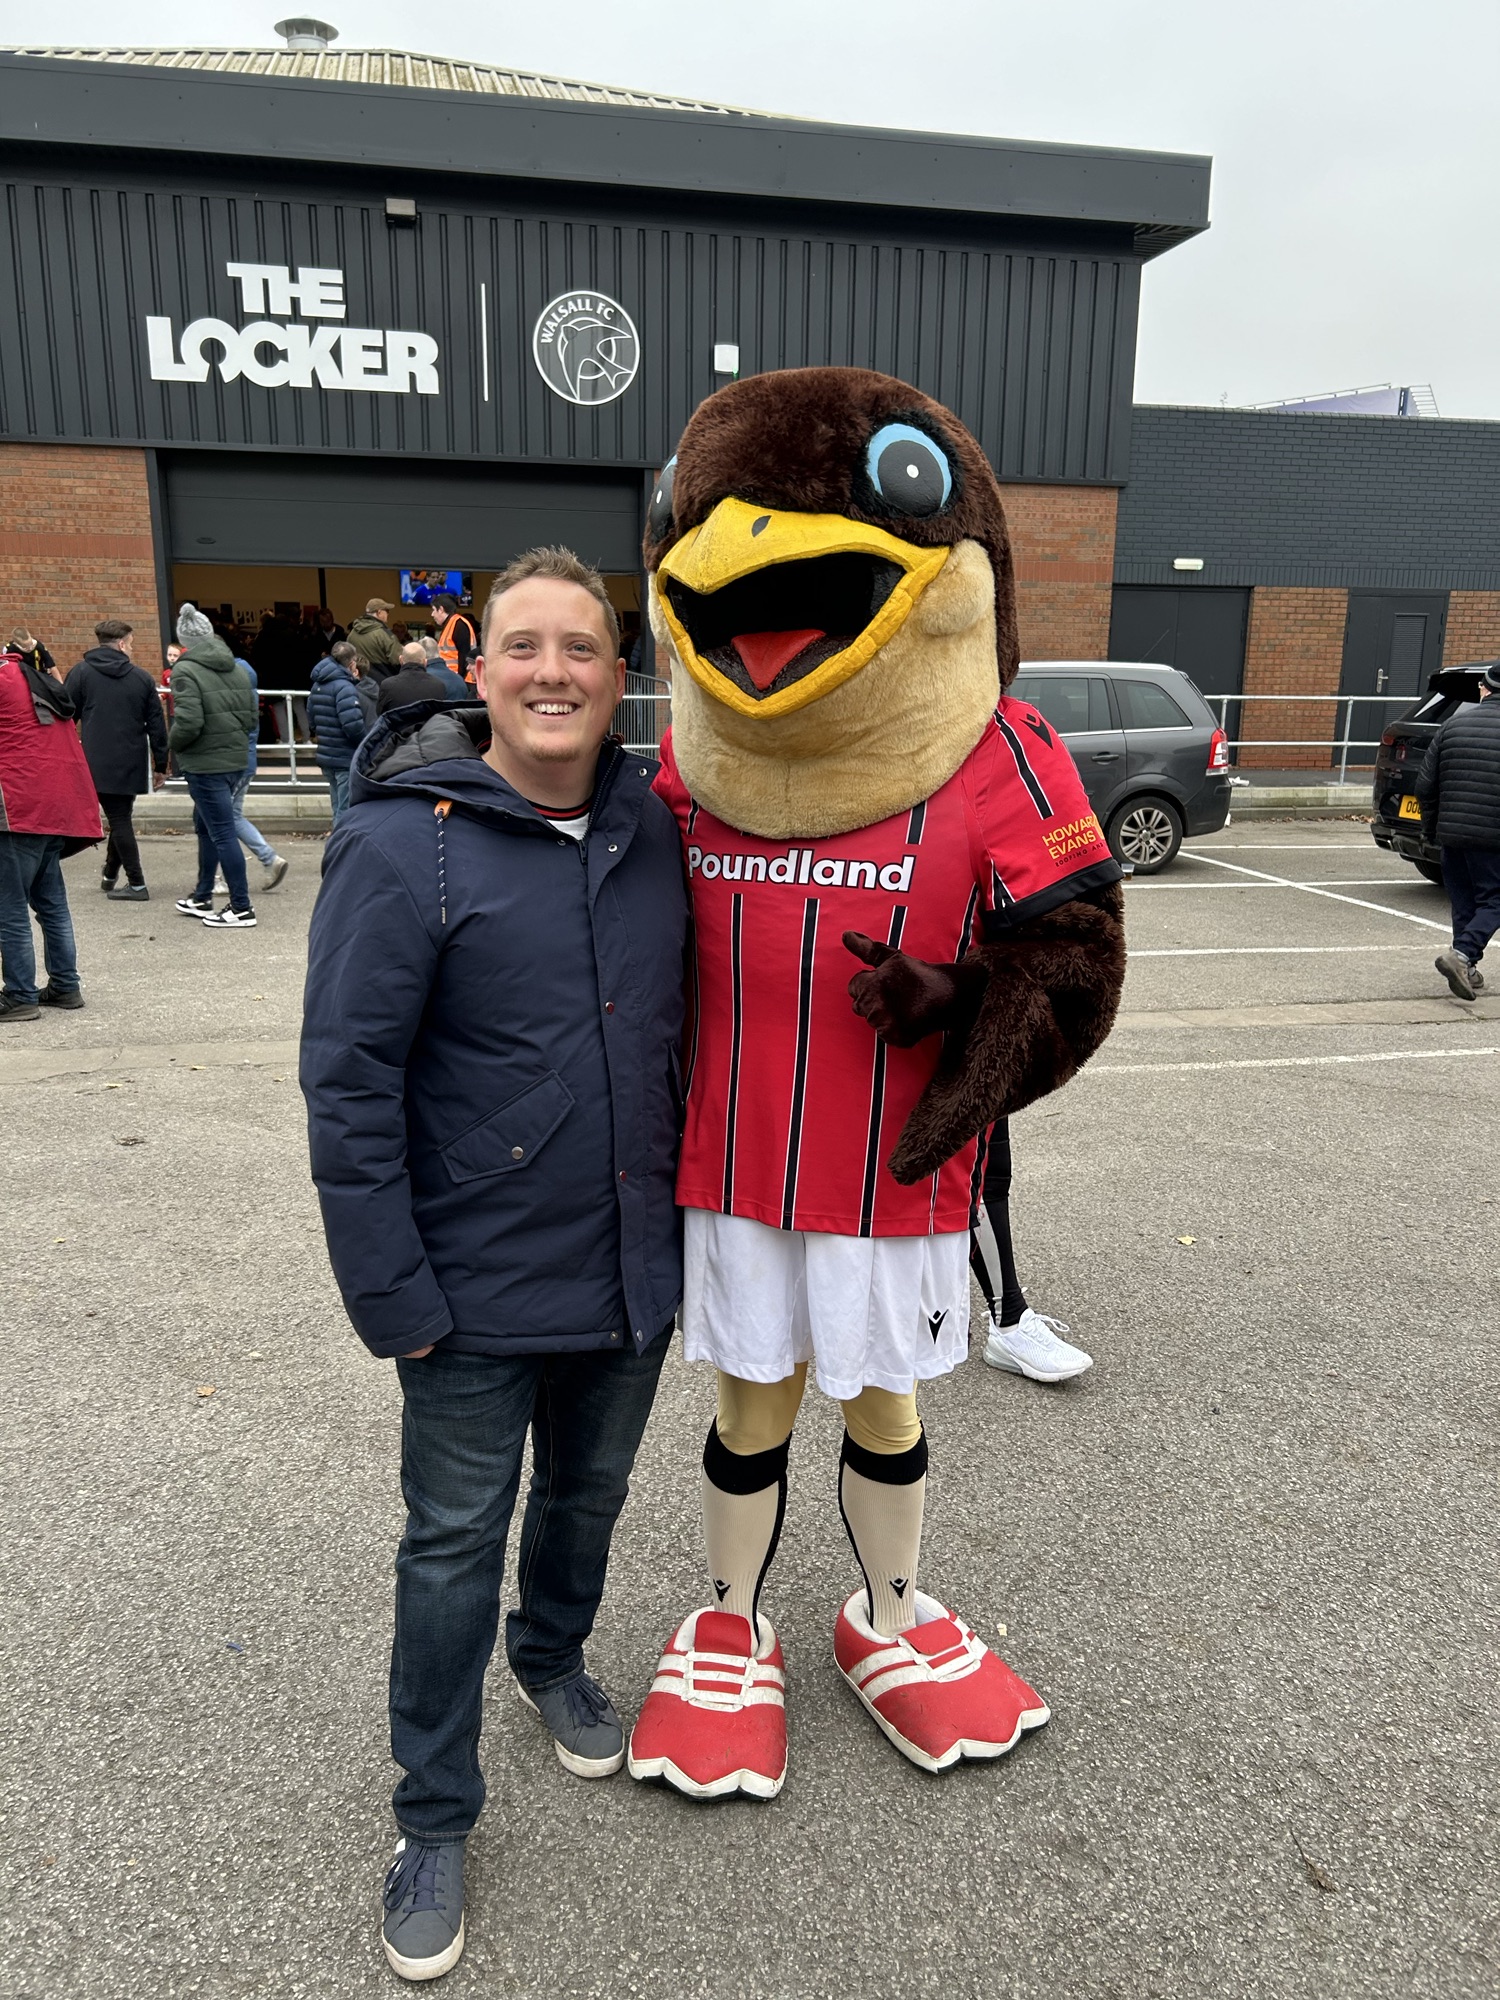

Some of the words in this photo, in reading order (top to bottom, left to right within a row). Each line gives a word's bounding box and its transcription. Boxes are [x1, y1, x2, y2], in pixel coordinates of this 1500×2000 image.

[226, 262, 346, 319] THE
[540, 298, 594, 344] WALSALL
[596, 302, 615, 321] FC
[146, 315, 439, 395] LOCKER
[687, 845, 917, 893] Poundland
[1048, 830, 1097, 860] EVANS
